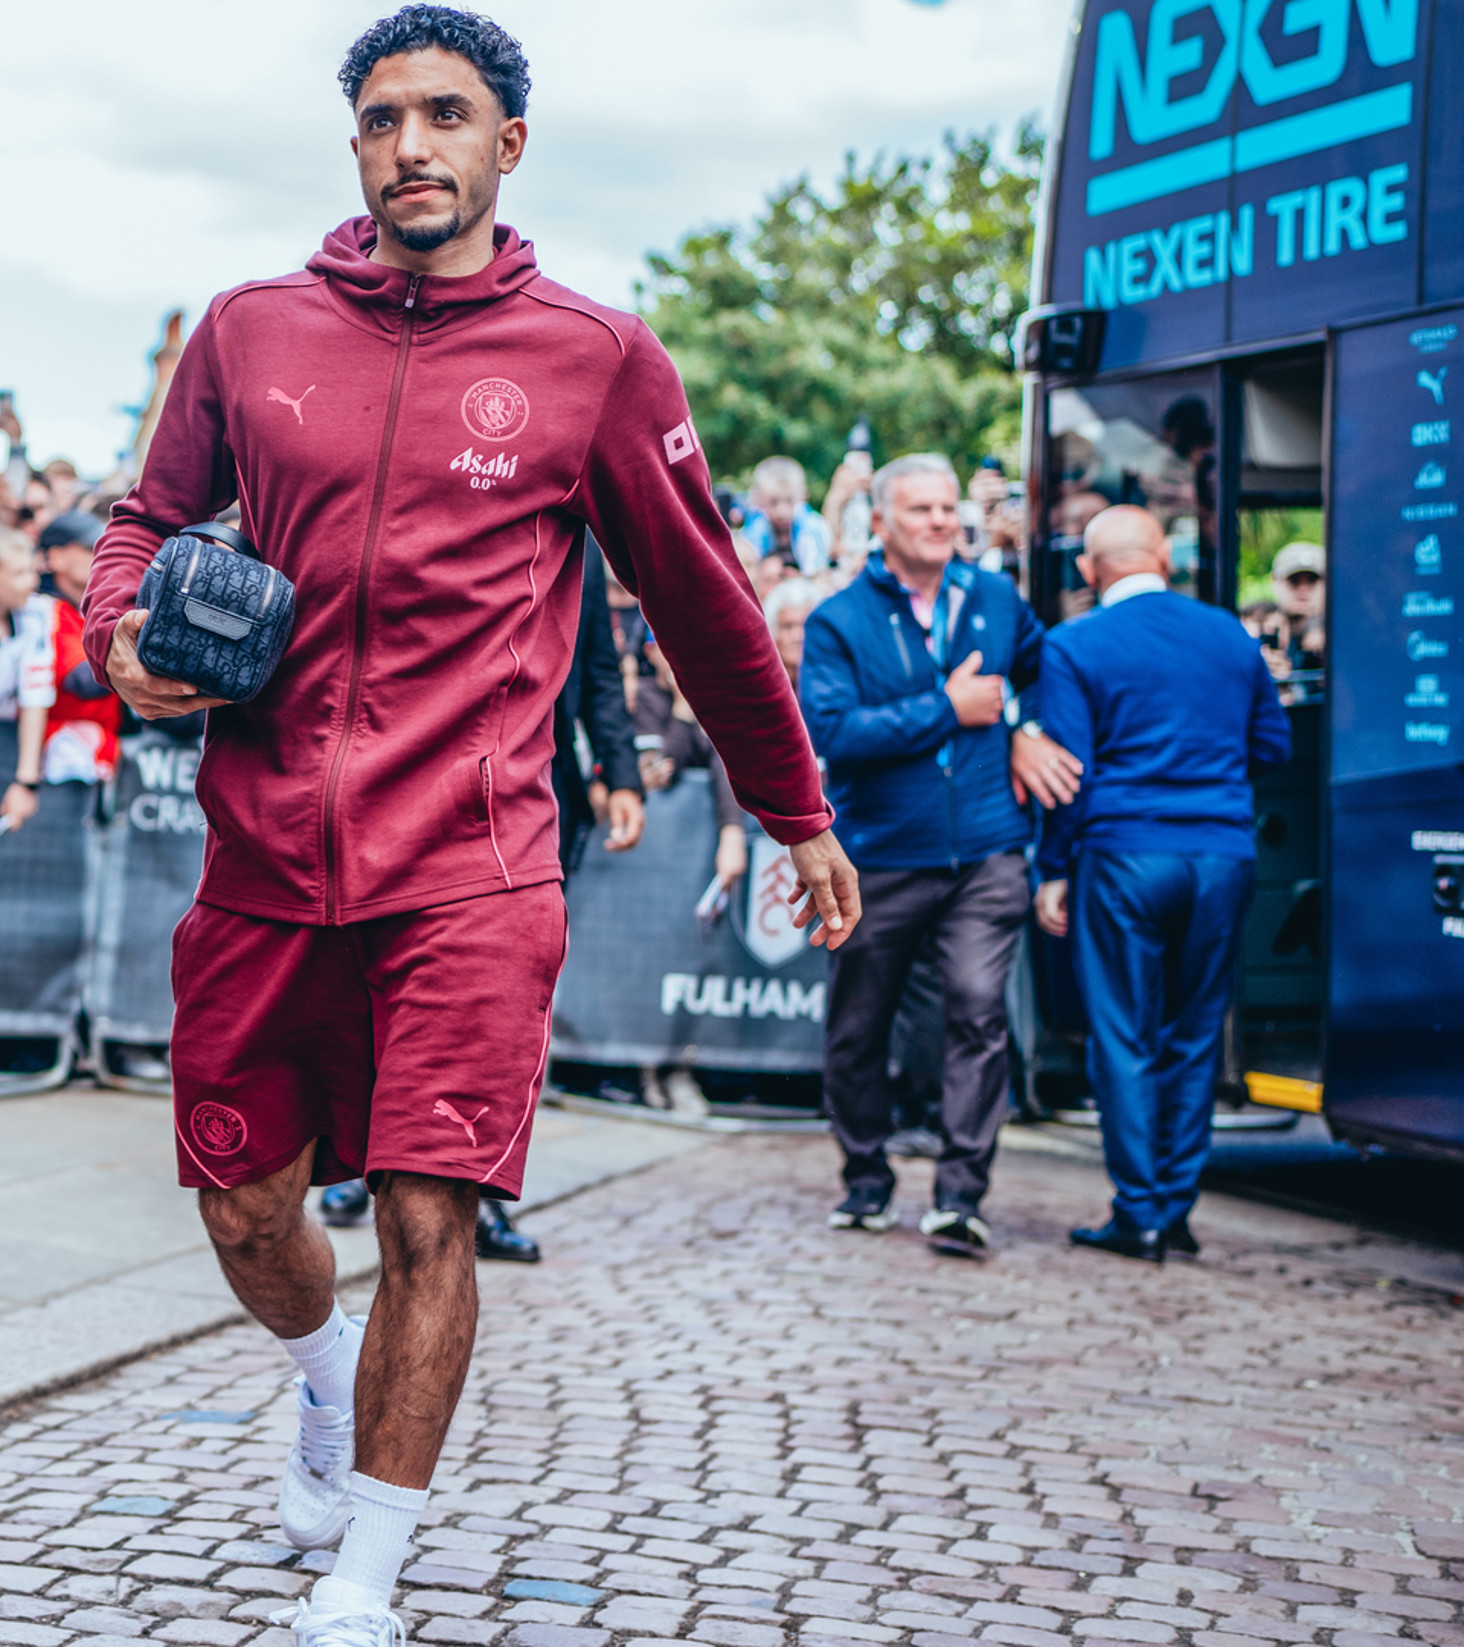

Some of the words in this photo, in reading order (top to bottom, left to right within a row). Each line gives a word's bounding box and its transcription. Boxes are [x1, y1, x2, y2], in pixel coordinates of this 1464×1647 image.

[1082, 202, 1255, 311] NEXEN
[1265, 162, 1410, 269] TIRE
[471, 382, 523, 405] MANCHESTER
[482, 428, 503, 437] CITY
[449, 446, 519, 480] Asahi
[136, 745, 202, 794] WE
[660, 971, 828, 1024] FULHAM
